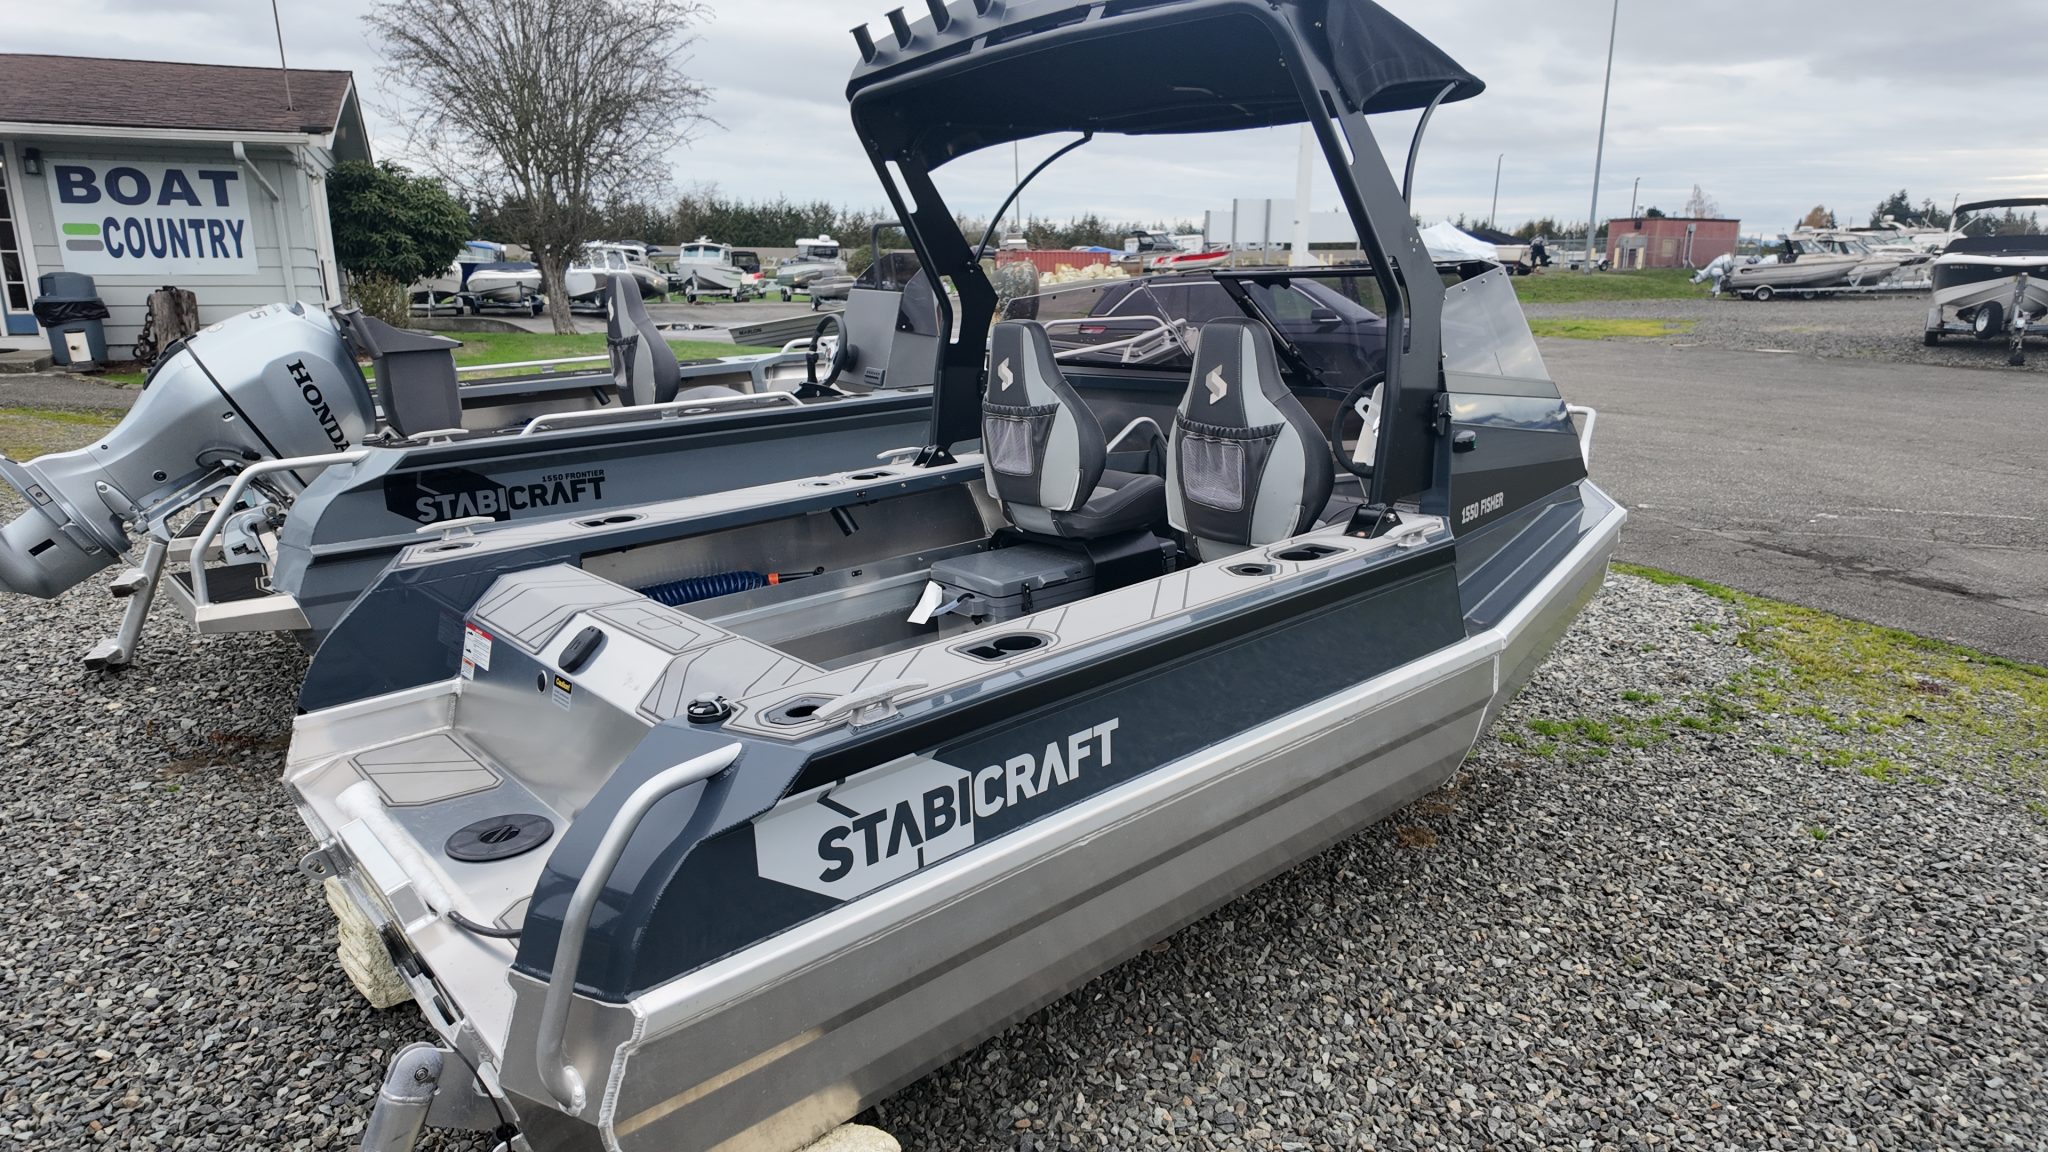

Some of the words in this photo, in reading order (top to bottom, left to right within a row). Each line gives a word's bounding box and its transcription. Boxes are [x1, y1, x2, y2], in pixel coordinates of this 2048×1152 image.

[54, 165, 239, 207] BOAT
[103, 216, 244, 259] COUNTRY
[286, 359, 350, 452] HONDA
[541, 473, 563, 482] 1550
[565, 469, 604, 480] FRONTIER
[416, 476, 606, 523] STABICRAFT
[1461, 501, 1479, 524] 1550
[1480, 491, 1504, 516] FISHER
[817, 717, 1119, 882] STABICRAFT
